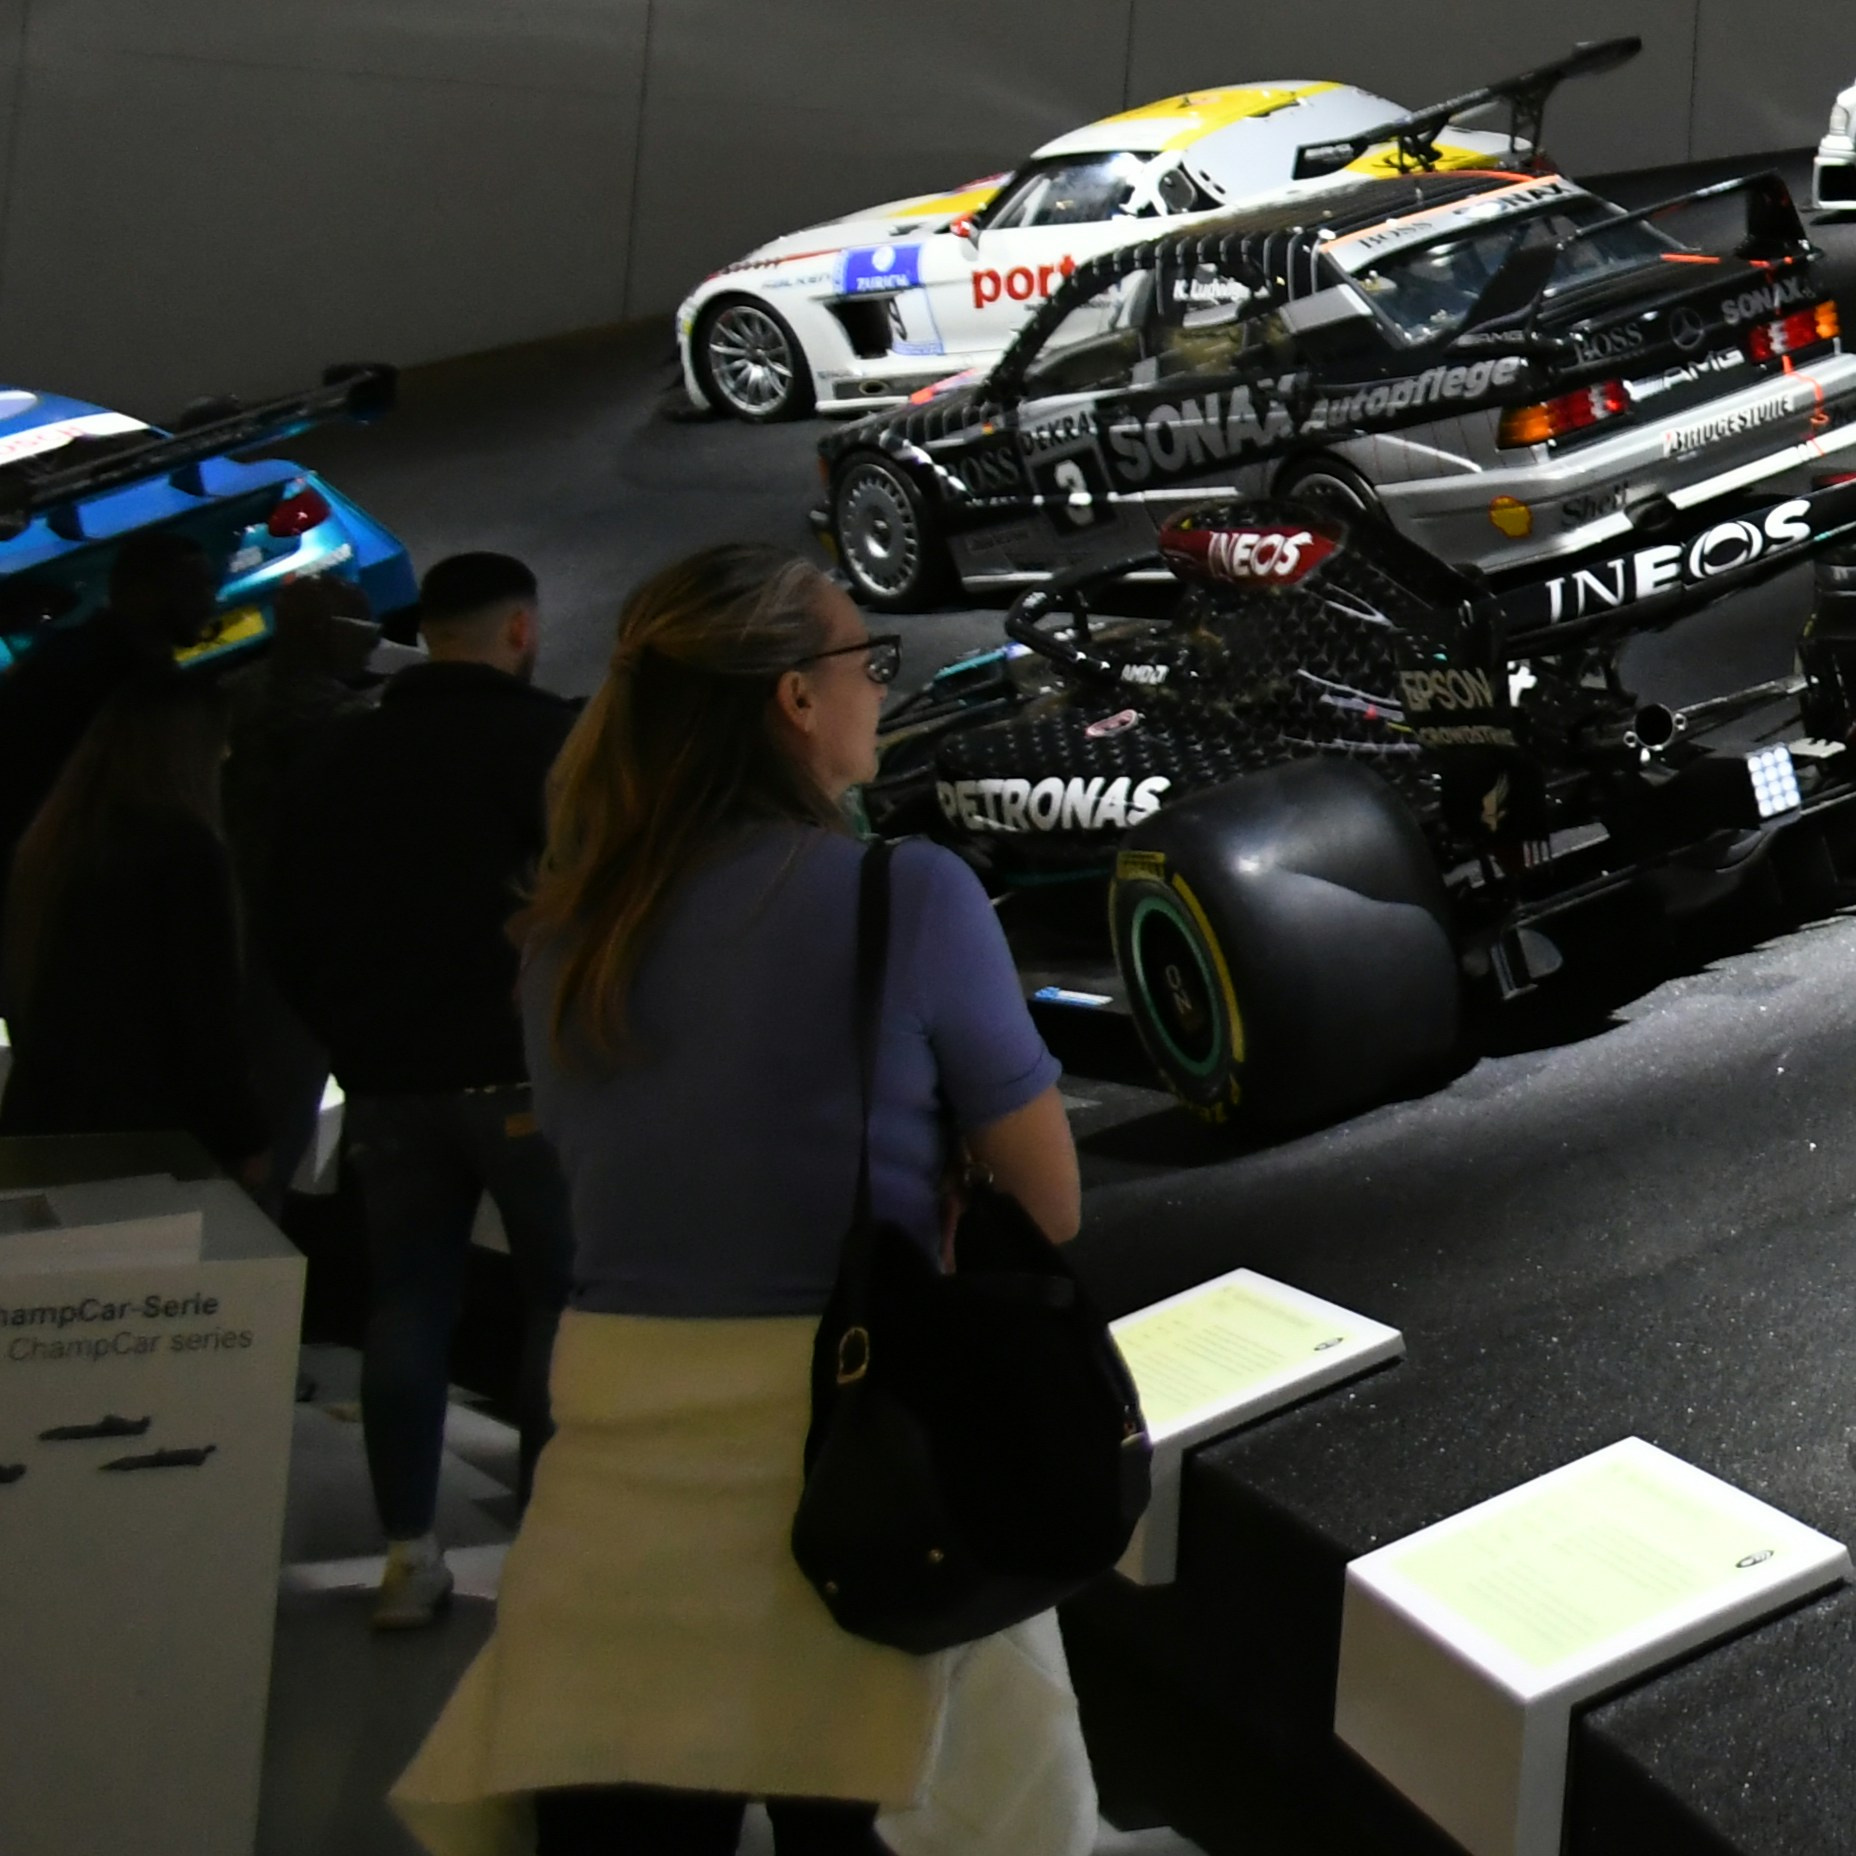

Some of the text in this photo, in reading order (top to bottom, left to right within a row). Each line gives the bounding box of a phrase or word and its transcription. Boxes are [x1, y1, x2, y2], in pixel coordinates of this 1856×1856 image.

[1359, 219, 1432, 251] BOSS
[1720, 277, 1803, 326] SONAX
[1300, 355, 1521, 435] Autopflege
[1020, 409, 1091, 457] DEKRA
[1108, 373, 1298, 481] SONAX
[1561, 481, 1630, 525] Shell
[1207, 530, 1313, 578] INEOS
[1548, 500, 1813, 621] INEOS
[1399, 666, 1494, 712] EPSON
[937, 775, 1173, 833] PETRONAS
[0, 1293, 219, 1329] ampCar-Serie
[8, 1326, 255, 1363] ChampCar series
